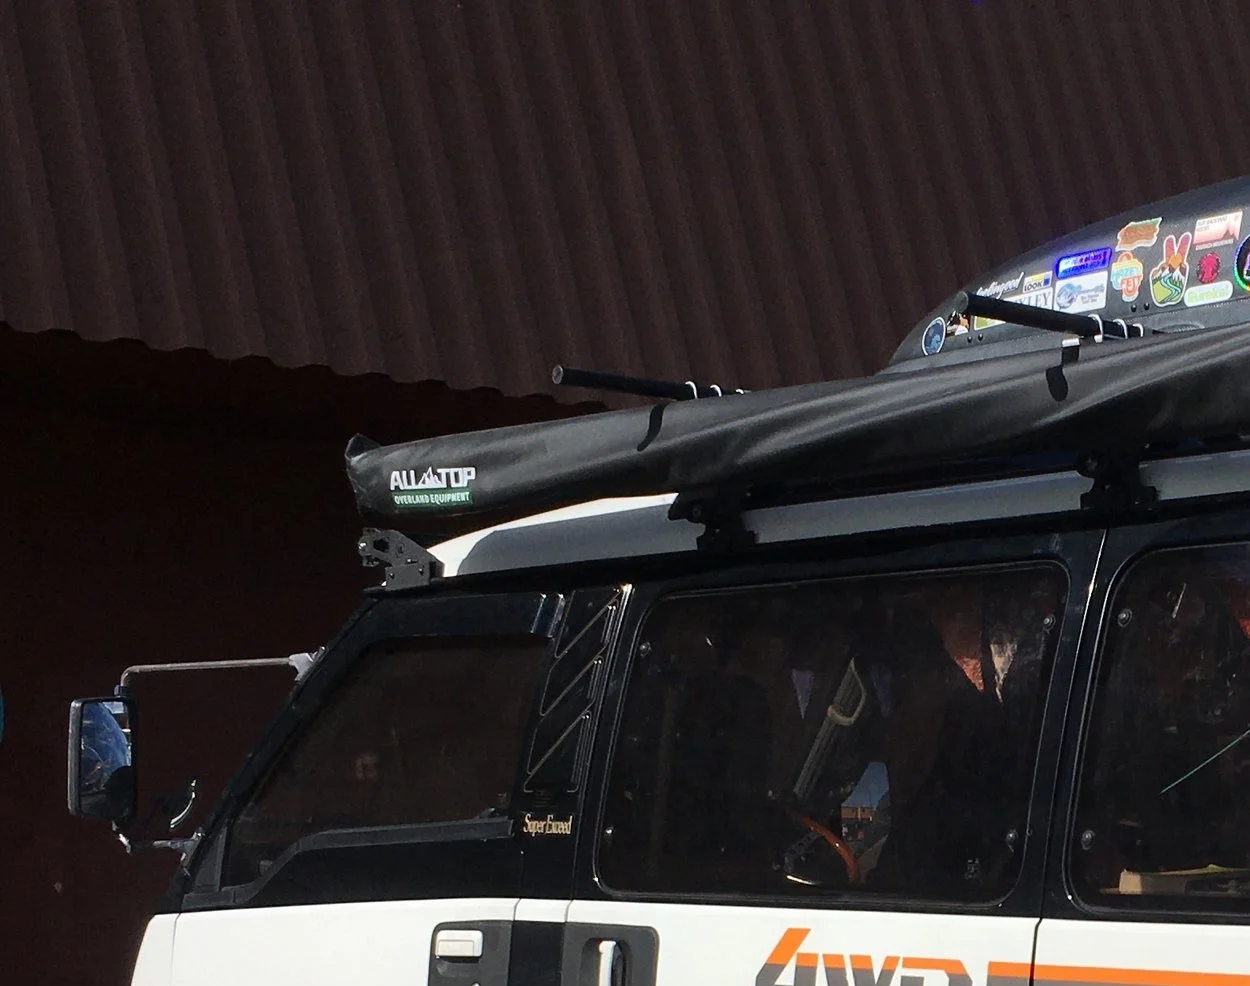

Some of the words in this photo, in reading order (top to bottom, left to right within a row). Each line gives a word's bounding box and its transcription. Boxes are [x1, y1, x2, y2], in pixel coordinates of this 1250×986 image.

[1024, 281, 1043, 292] LOOK
[394, 494, 429, 505] OVERLAND
[430, 492, 470, 504] EQUIPMENT
[523, 813, 545, 837] Super
[545, 814, 573, 835] Exceed
